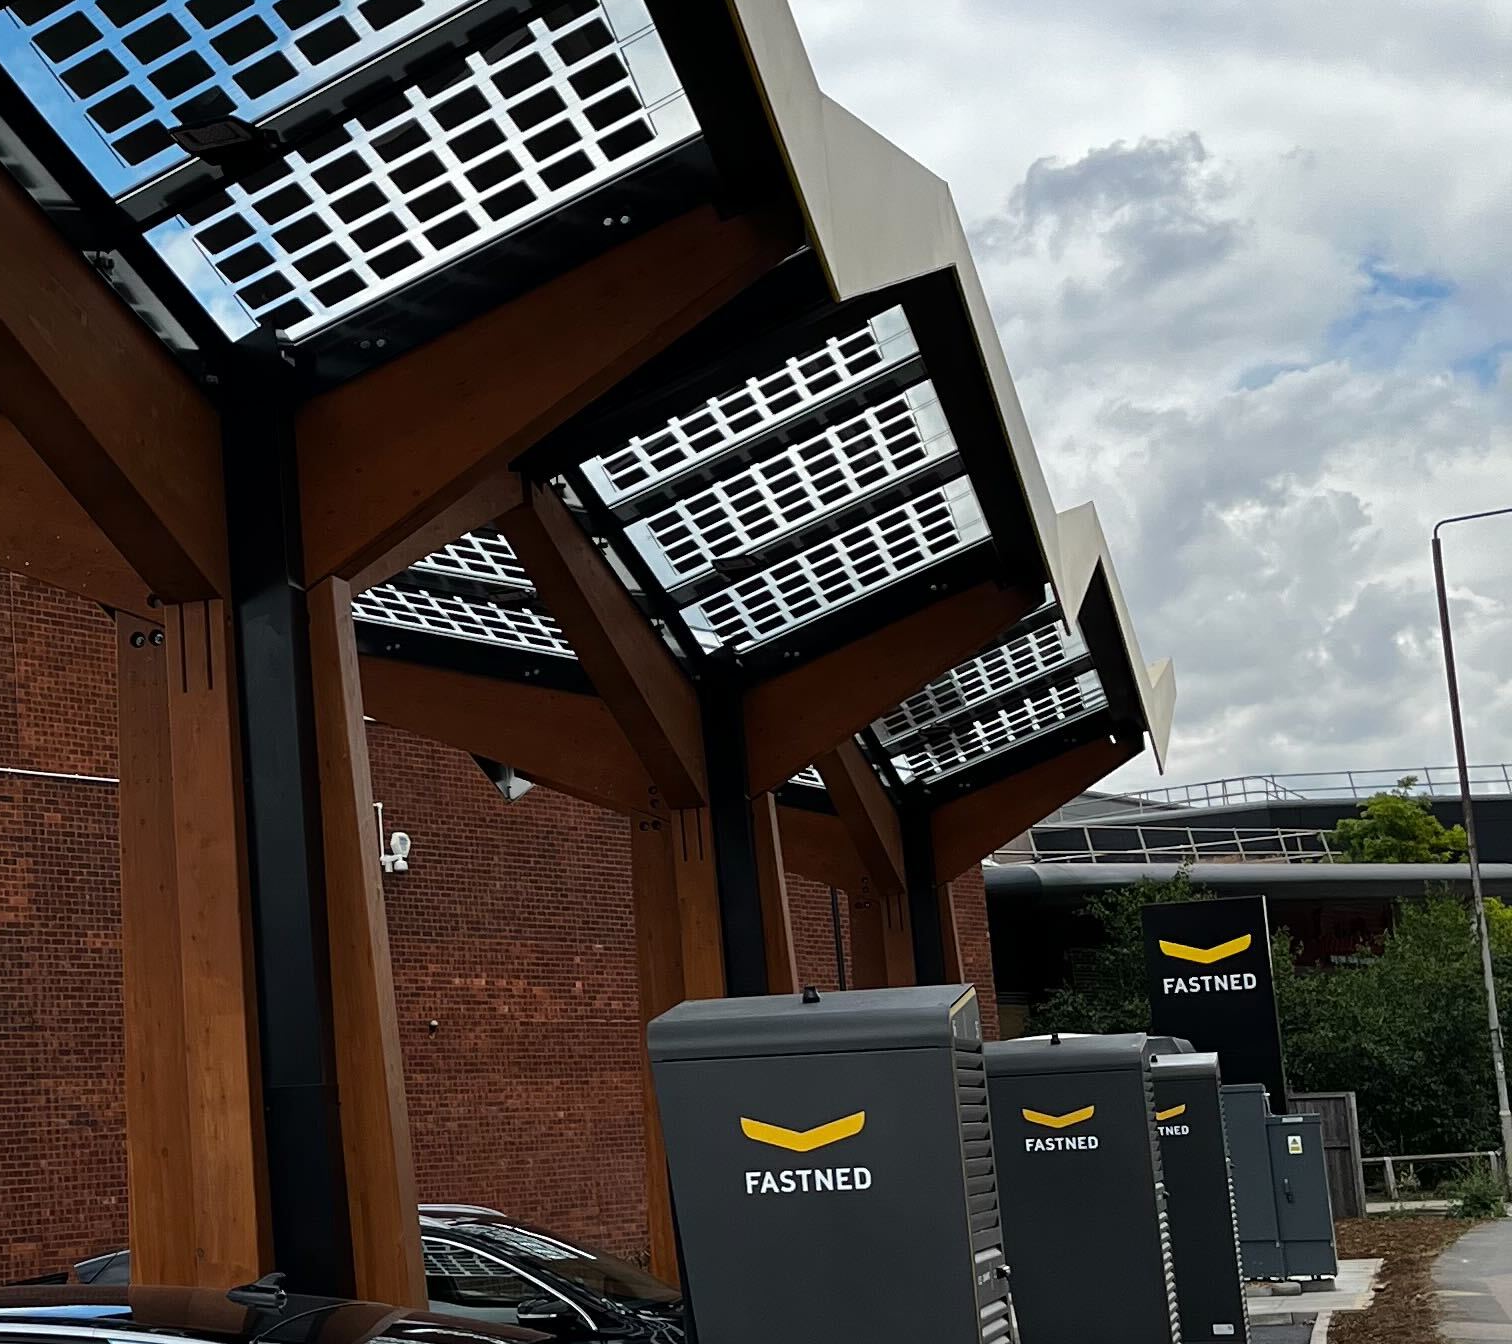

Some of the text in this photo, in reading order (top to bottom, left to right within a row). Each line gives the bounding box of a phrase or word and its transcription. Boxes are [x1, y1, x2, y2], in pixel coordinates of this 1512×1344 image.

[1163, 973, 1257, 995] FASTNED
[1157, 1125, 1190, 1137] TNED
[1025, 1136, 1099, 1152] FASTNED
[745, 1167, 872, 1195] FASTNED
